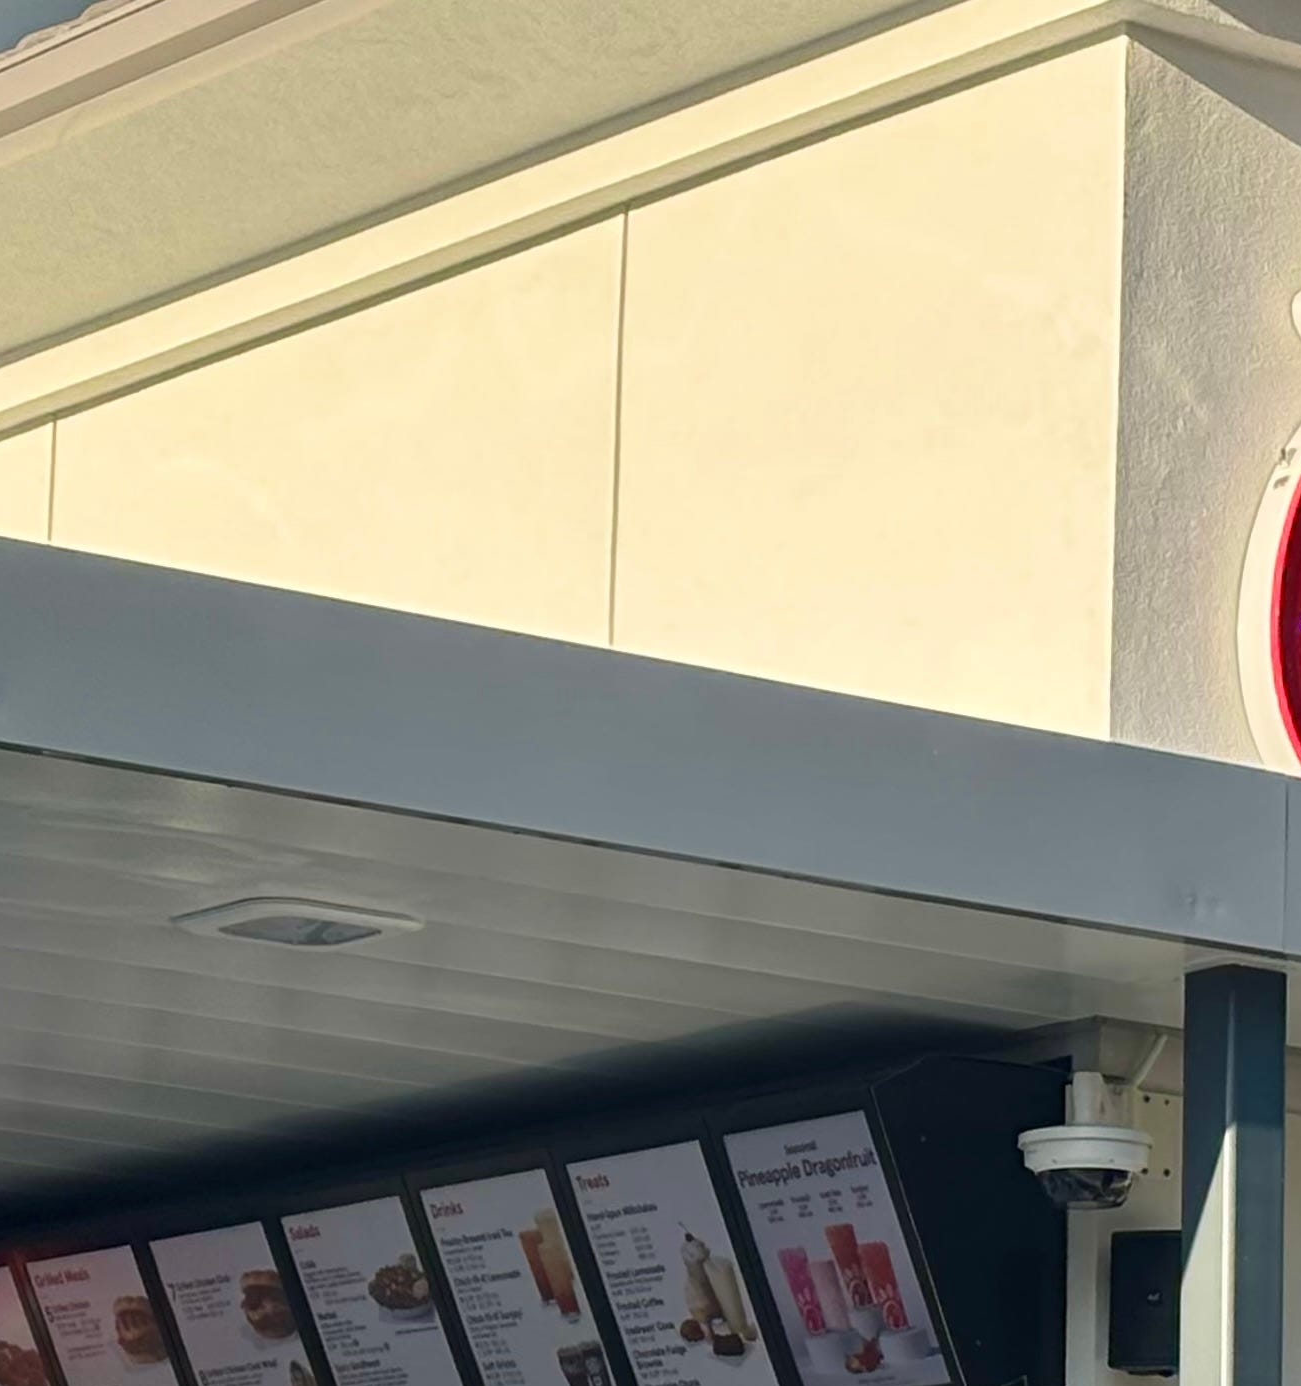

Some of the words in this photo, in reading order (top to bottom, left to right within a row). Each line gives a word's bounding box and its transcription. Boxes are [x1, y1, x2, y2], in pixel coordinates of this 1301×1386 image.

[737, 1162, 801, 1188] Pineapple
[802, 1147, 878, 1178] Dragonfruit
[432, 1204, 463, 1218] Drinks
